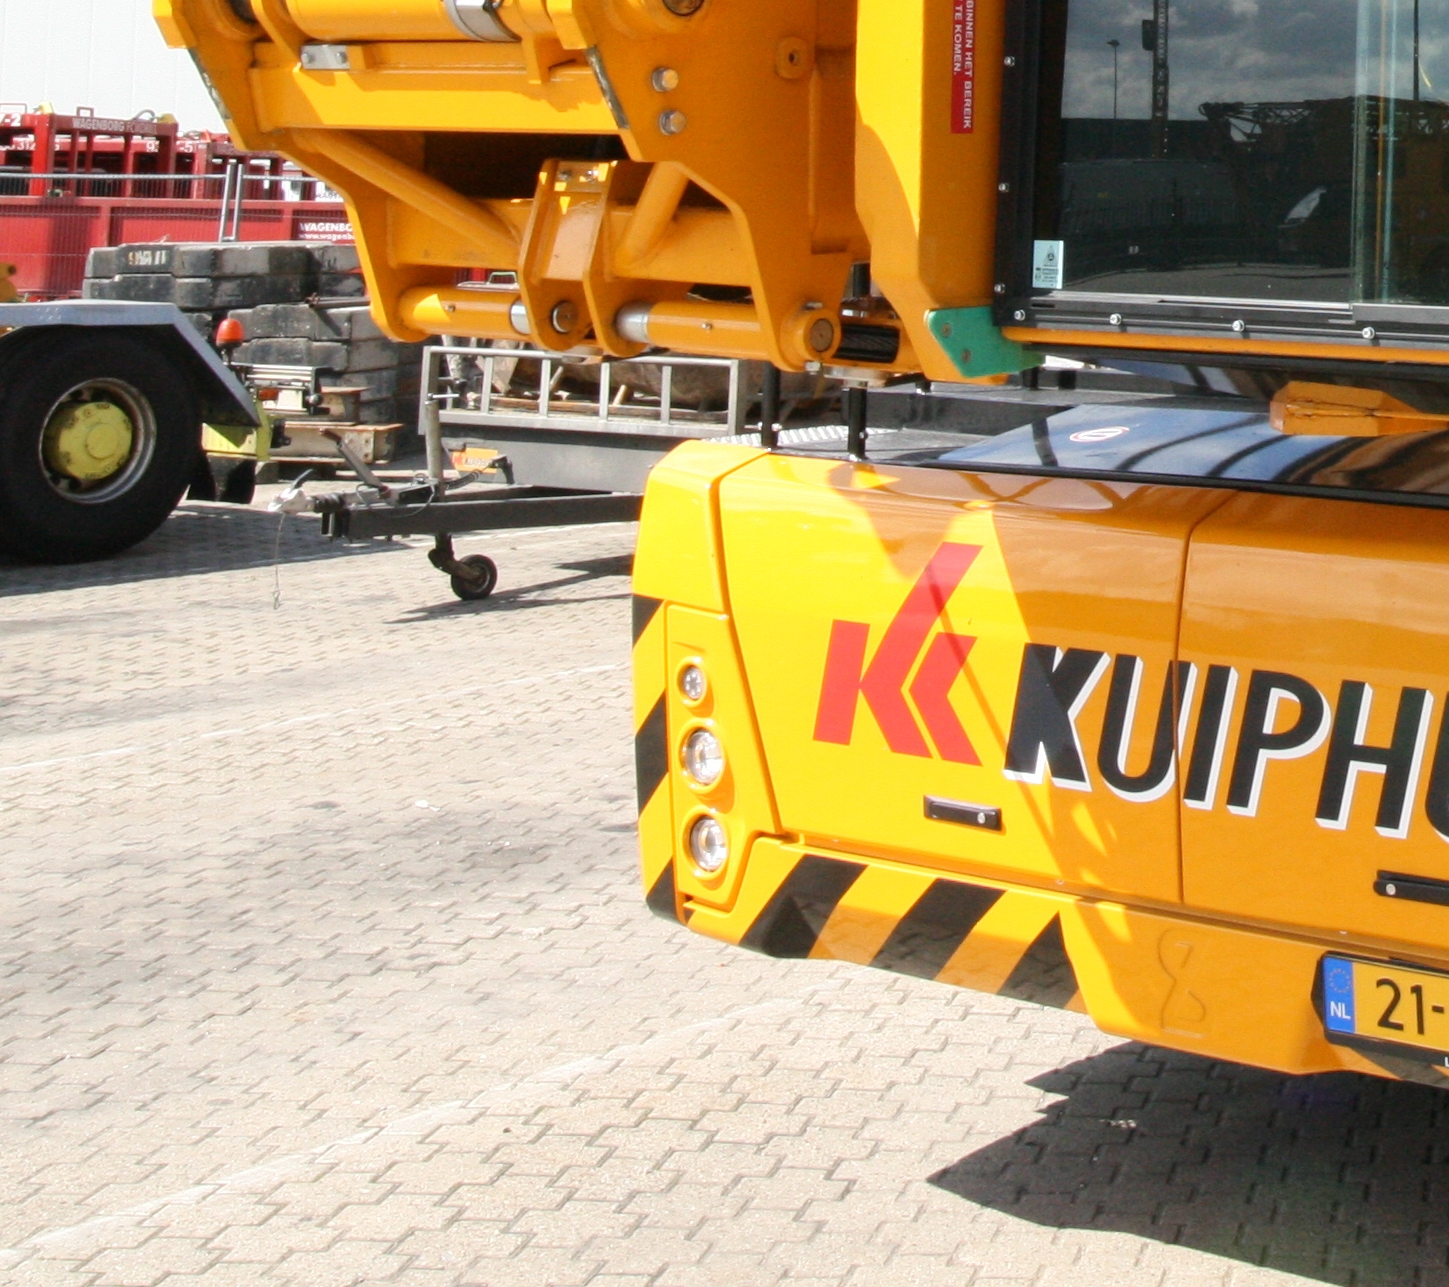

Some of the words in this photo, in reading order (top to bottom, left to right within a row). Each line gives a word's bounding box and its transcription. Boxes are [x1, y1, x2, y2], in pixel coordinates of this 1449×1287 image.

[954, 5, 963, 21] TE
[965, 0, 975, 48] BINNEN
[953, 23, 963, 75] KOMEN.
[964, 51, 973, 78] HET
[963, 80, 972, 129] BEREIK
[1330, 1000, 1351, 1021] NL
